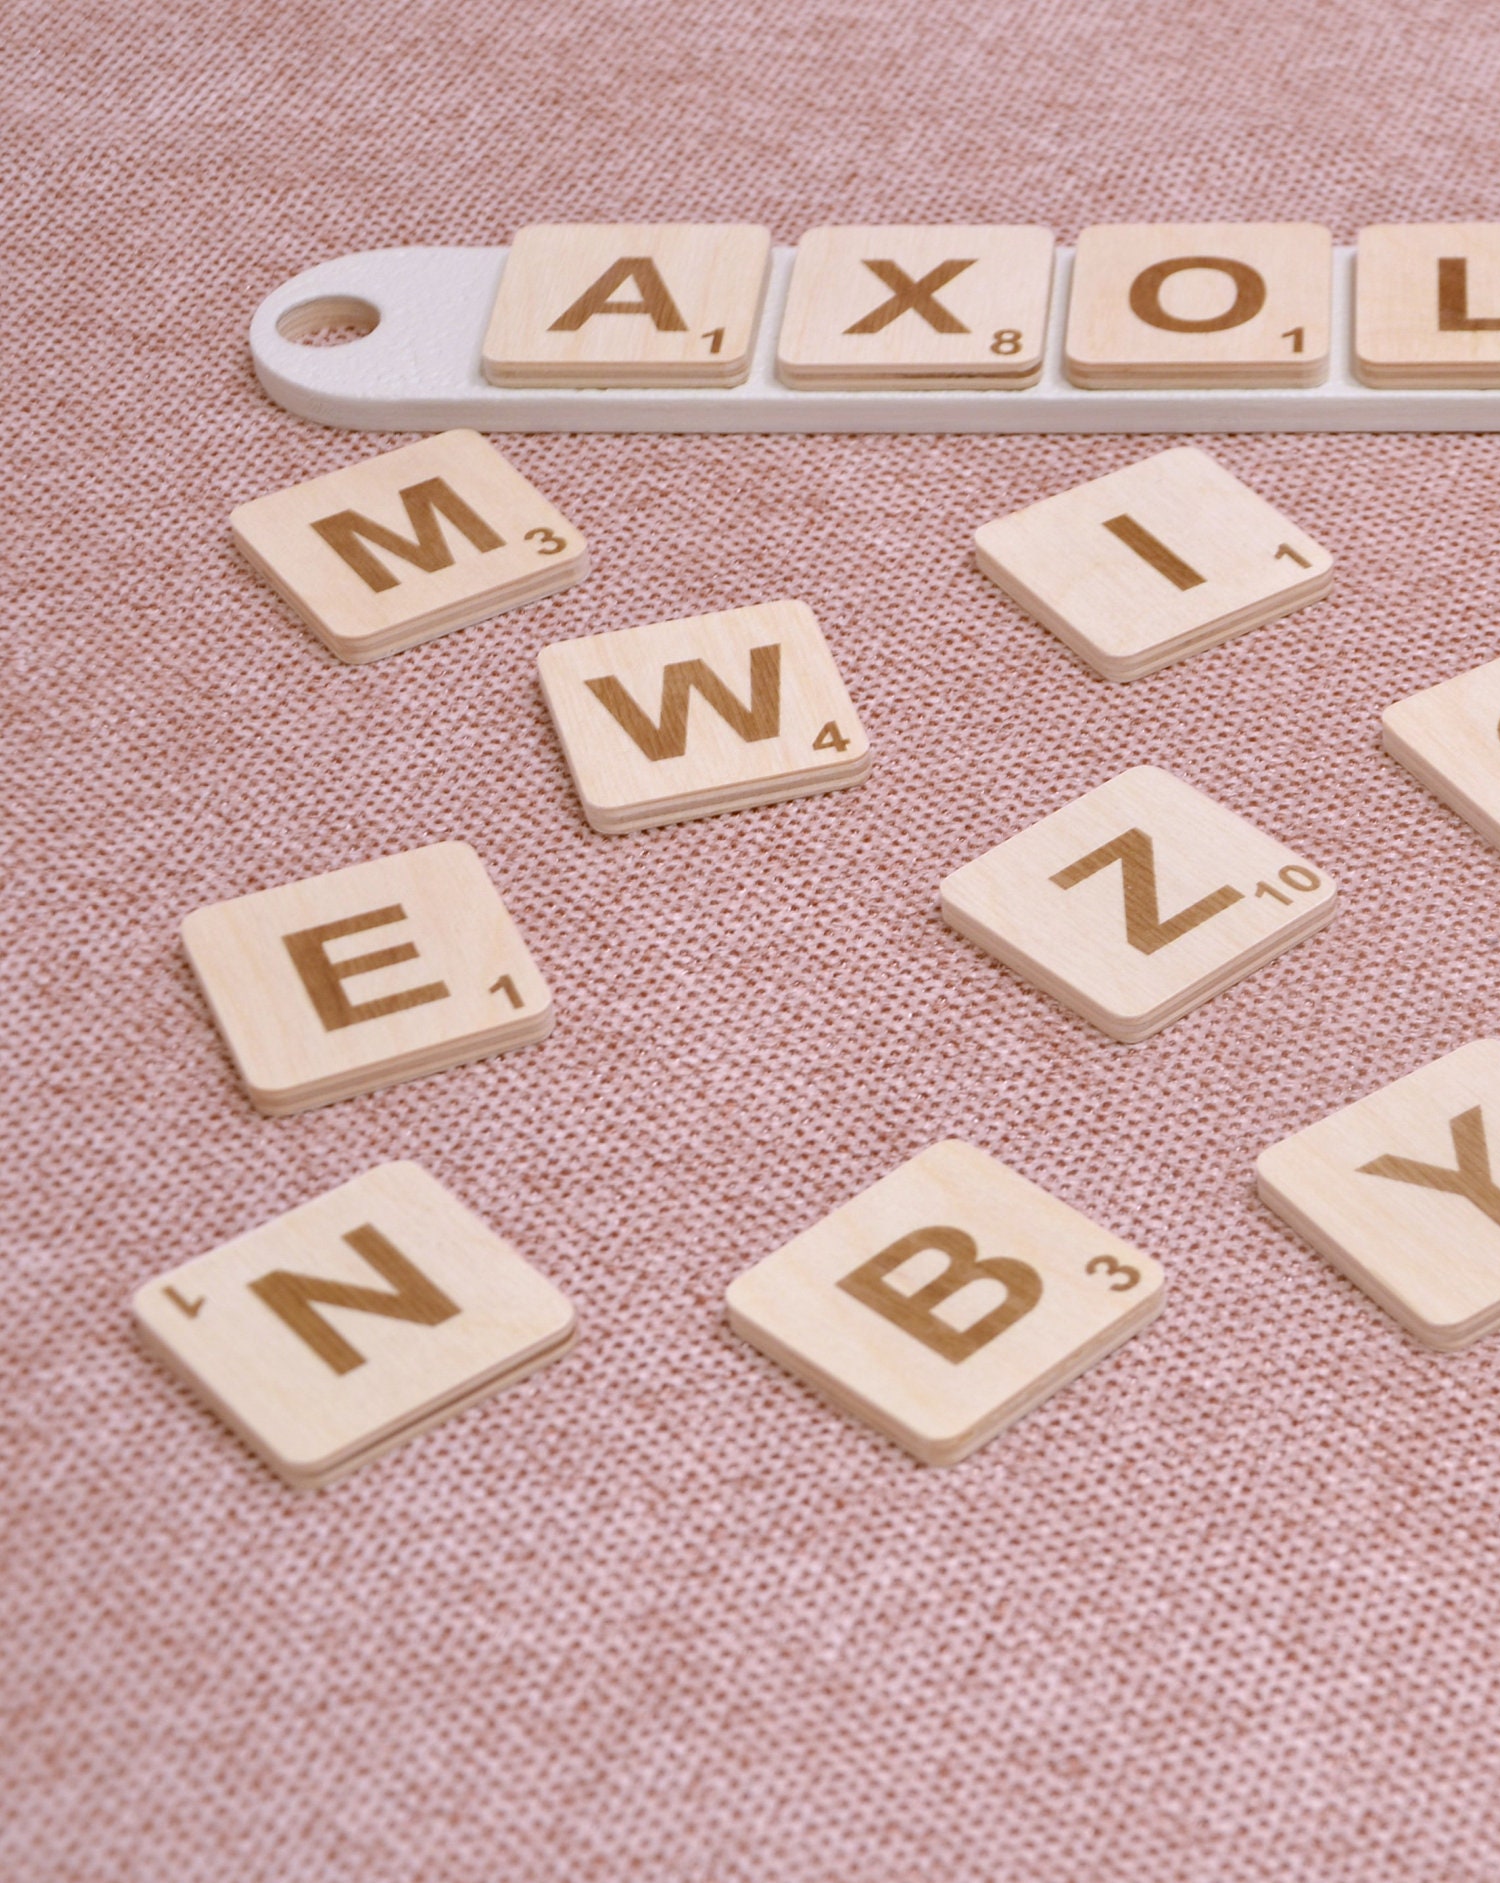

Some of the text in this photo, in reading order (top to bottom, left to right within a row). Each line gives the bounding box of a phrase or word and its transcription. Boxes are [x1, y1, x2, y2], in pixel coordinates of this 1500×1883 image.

[549, 257, 688, 332] A
[843, 260, 977, 334] X
[1129, 257, 1266, 333] O
[702, 328, 724, 354] 1
[990, 330, 1022, 355] 8
[1282, 327, 1304, 353] 1
[310, 477, 505, 593] M
[524, 528, 566, 555] 3
[1102, 514, 1206, 591] I
[1274, 544, 1312, 569] 1
[584, 644, 780, 762] W
[813, 721, 850, 752] 4
[1049, 828, 1245, 955] Z
[1255, 865, 1321, 905] 10
[282, 904, 450, 1032] E
[489, 975, 524, 1009] 1
[1085, 1255, 1140, 1292] 3
[162, 1286, 205, 1319] 1
[248, 1224, 461, 1376] N
[836, 1226, 1043, 1364] B
